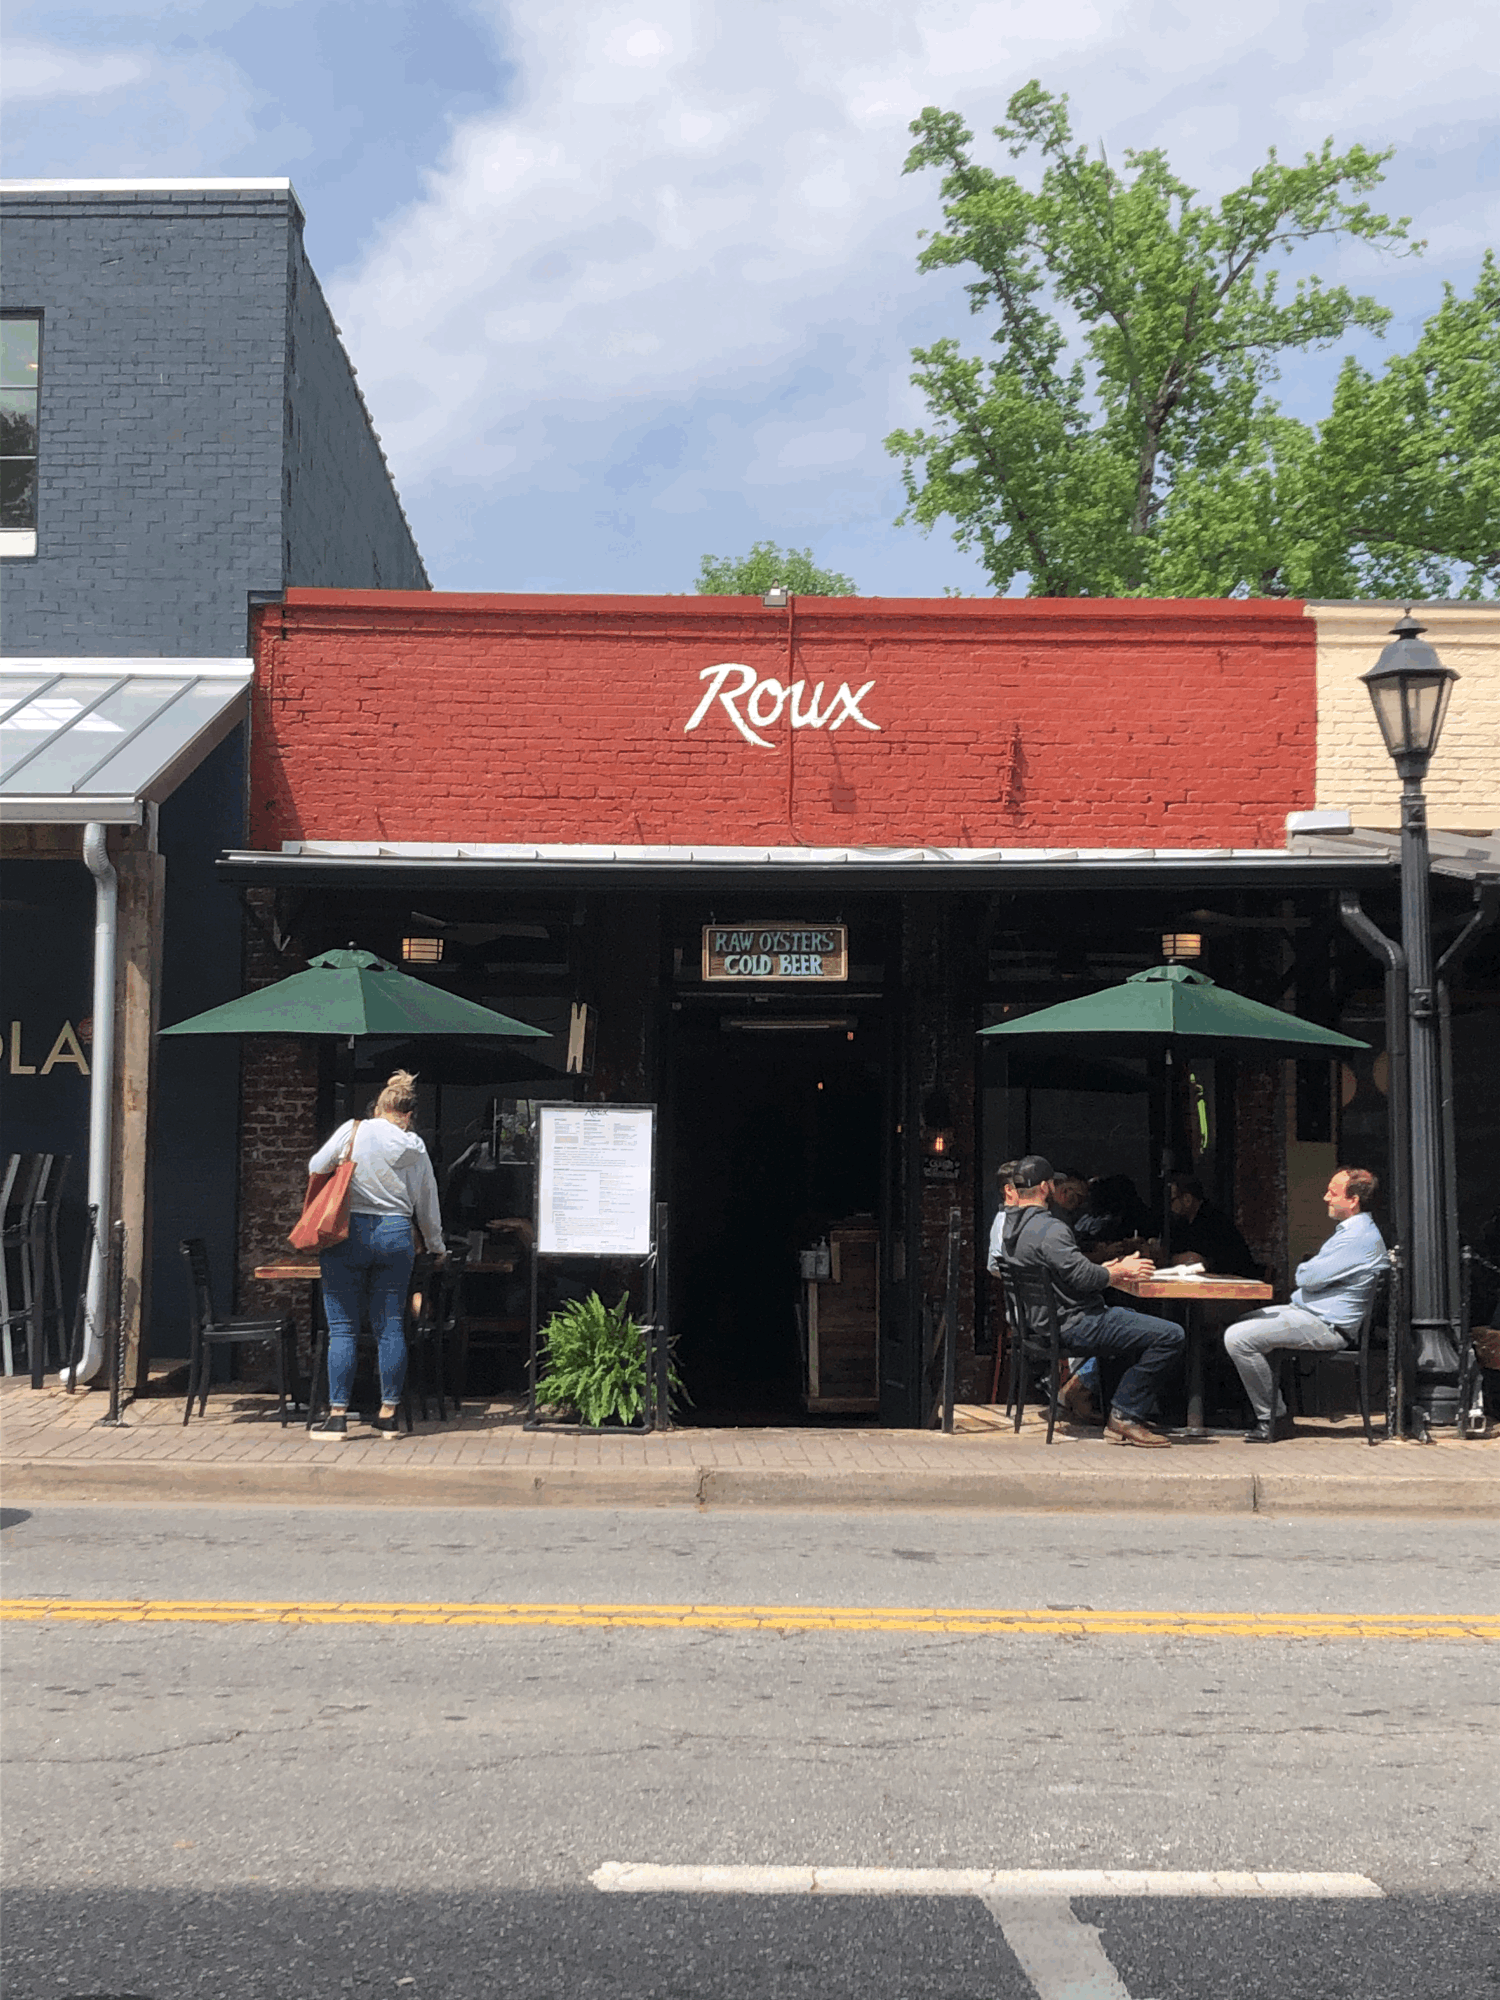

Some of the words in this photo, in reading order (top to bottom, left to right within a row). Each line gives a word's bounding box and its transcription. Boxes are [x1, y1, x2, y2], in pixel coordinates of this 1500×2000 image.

[684, 662, 882, 748] Roux
[715, 931, 754, 952] RAW
[759, 931, 835, 951] OYSTERS
[724, 954, 772, 975] COLD
[778, 954, 823, 975] BEER
[0, 1020, 91, 1075] LA
